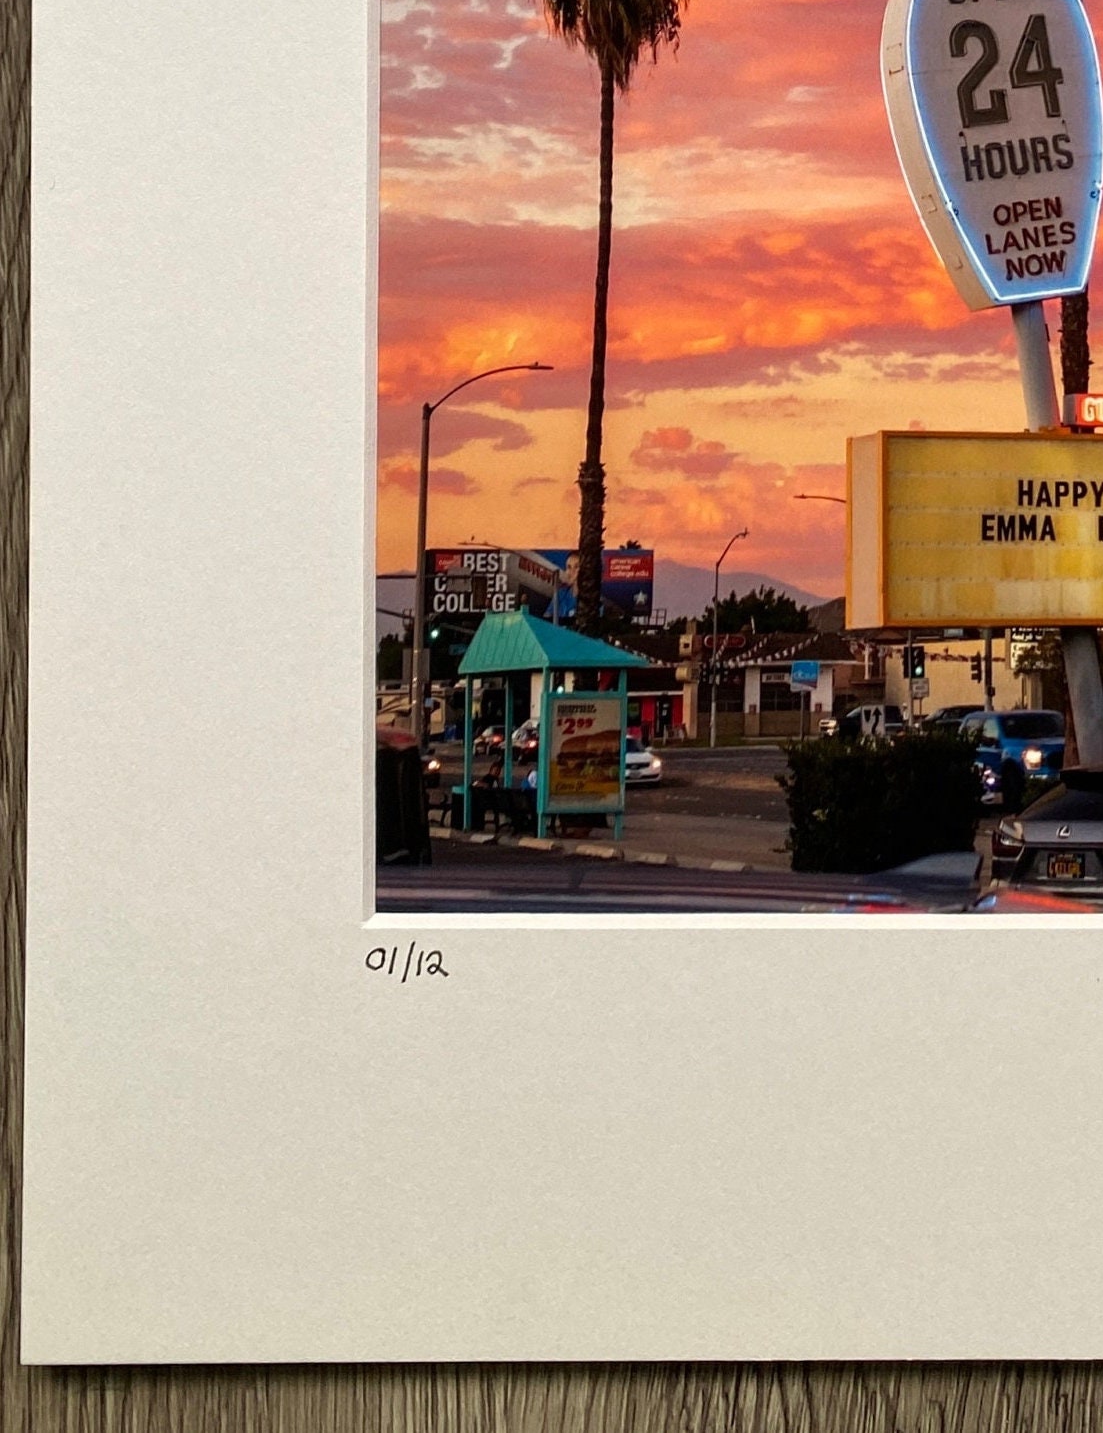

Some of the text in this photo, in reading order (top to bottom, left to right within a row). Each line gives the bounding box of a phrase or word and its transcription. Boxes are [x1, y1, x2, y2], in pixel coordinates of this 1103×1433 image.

[950, 14, 1064, 128] 24
[960, 133, 1074, 182] HOURS
[992, 196, 1063, 227] OPEN
[985, 221, 1076, 255] LANES
[1005, 249, 1067, 281] NOW
[981, 514, 1056, 542] EMMA
[463, 553, 510, 572] BEST
[433, 593, 516, 613] COLLGE
[365, 941, 450, 984] 01/12
